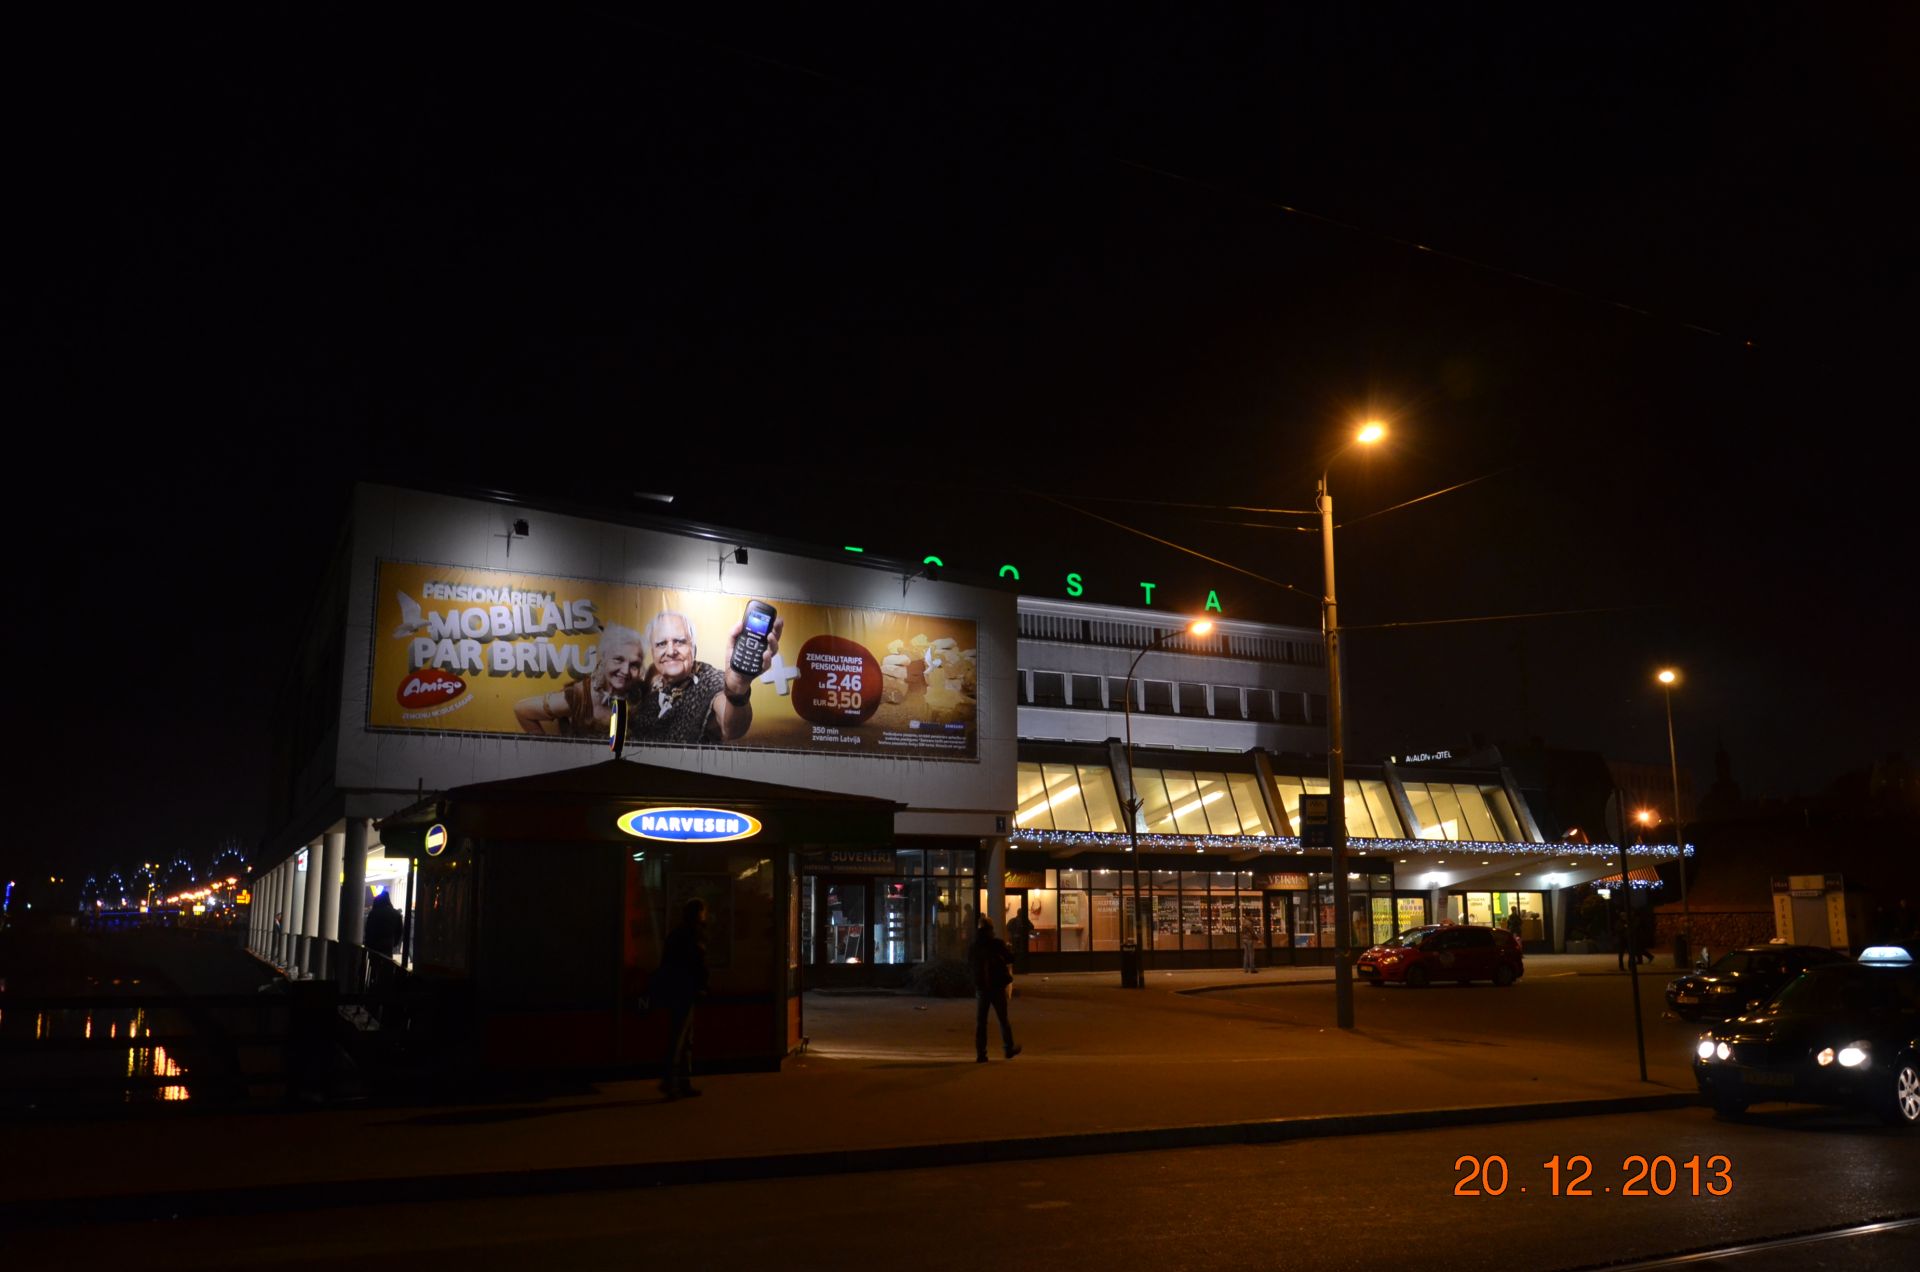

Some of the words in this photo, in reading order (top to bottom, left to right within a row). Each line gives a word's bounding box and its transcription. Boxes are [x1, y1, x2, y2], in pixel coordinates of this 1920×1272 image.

[428, 600, 595, 640] MOBILAIS
[413, 638, 484, 670] PAR
[840, 656, 863, 665] TARIFS
[403, 677, 462, 697] Amigo
[826, 672, 862, 692] 2,46
[813, 698, 827, 706] EUR
[827, 690, 862, 709] 3,50
[812, 726, 826, 734] 350
[826, 727, 839, 735] min
[641, 816, 739, 833] NARVESEN
